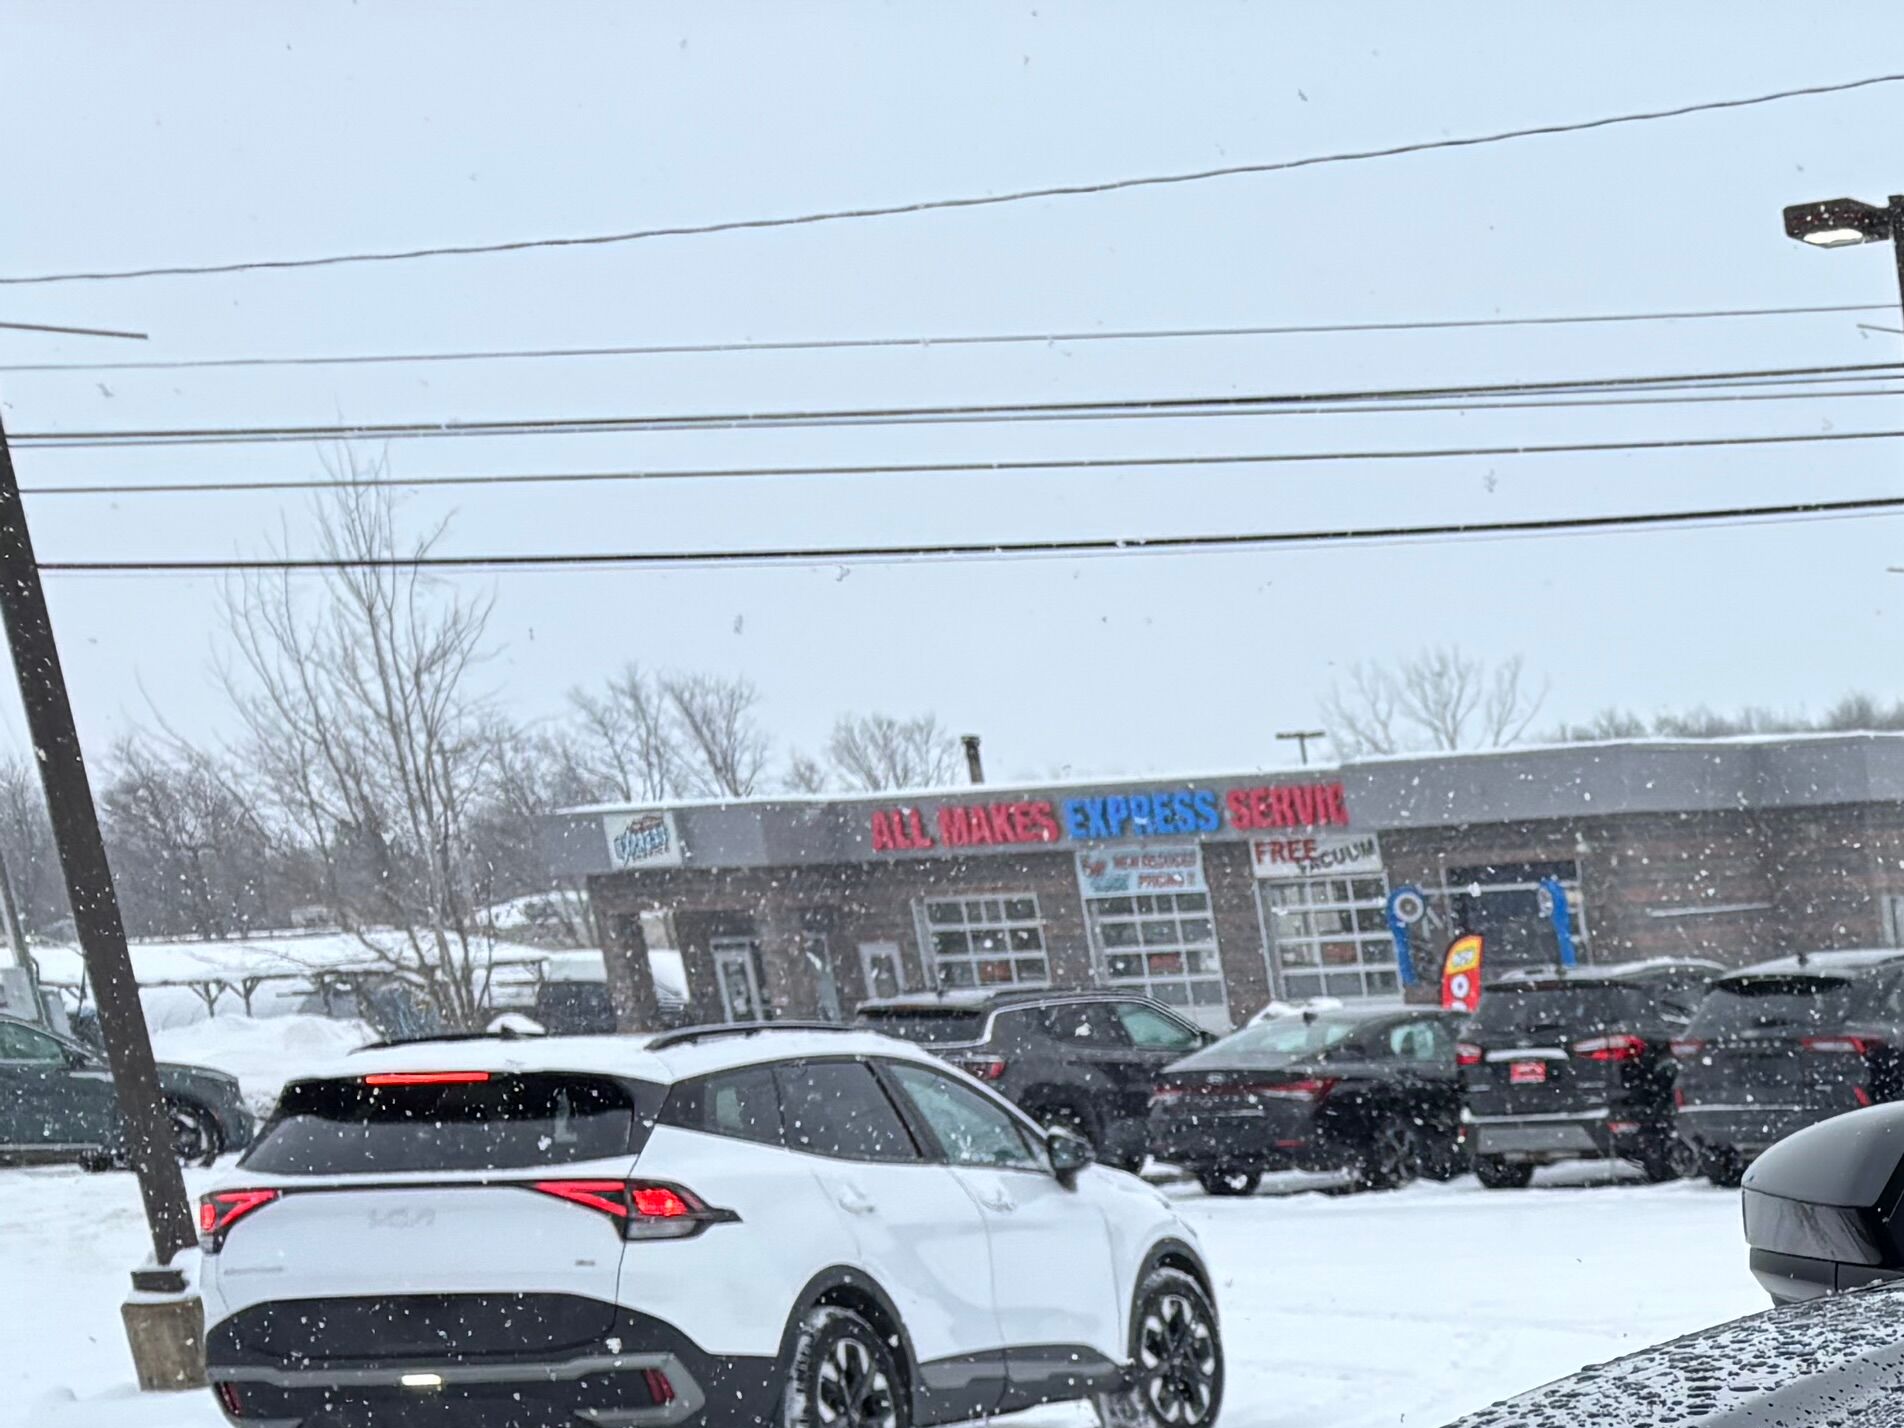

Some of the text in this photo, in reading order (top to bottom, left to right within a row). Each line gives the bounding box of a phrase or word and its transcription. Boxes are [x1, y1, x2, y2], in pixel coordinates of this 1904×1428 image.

[871, 808, 934, 851] ALL
[938, 801, 1060, 846] MAKES
[1064, 791, 1220, 840] EXPRESS
[1254, 839, 1317, 864] FREE
